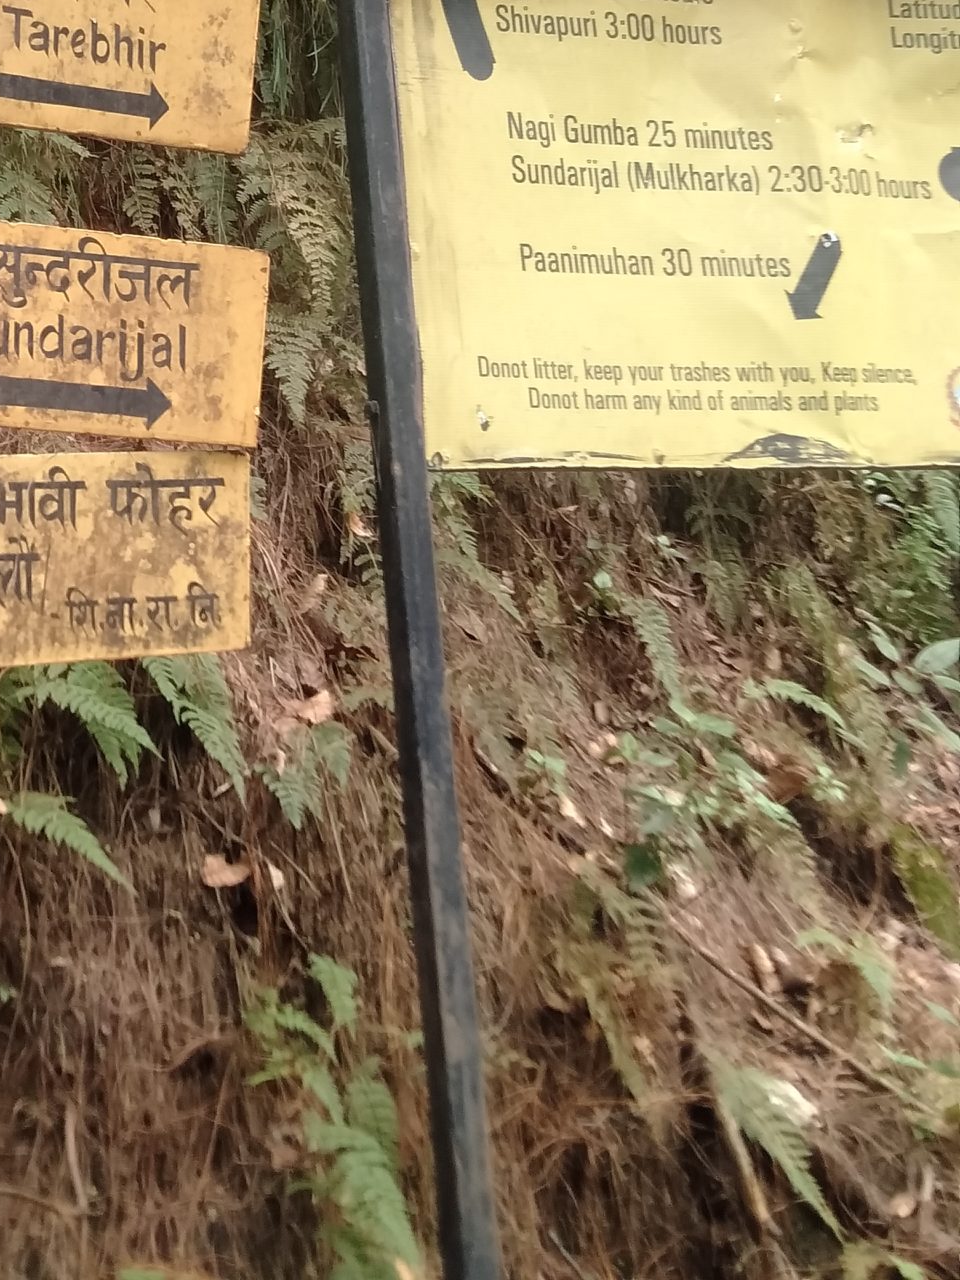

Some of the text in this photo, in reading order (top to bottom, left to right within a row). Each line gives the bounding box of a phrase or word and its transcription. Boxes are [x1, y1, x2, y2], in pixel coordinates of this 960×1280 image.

[2, 5, 167, 73] Tarebhir
[496, 5, 723, 47] Shivapuri 3:00 hours
[890, 26, 960, 54] Longit
[506, 111, 773, 153] Nagi Gumba 25 minutes
[511, 155, 619, 196] Sundarijal
[627, 161, 761, 196] (Mulkharka)
[876, 172, 932, 200] hours
[519, 243, 791, 279] Paanimuhan 30 minutes
[477, 355, 529, 379] Donot
[533, 357, 579, 383] litter,
[583, 359, 623, 386] keep
[628, 365, 664, 386] your
[670, 361, 730, 382] trashes
[735, 361, 774, 382] with
[821, 361, 858, 387] Keep
[528, 387, 880, 416] Donot harm any kind of animals and plants
